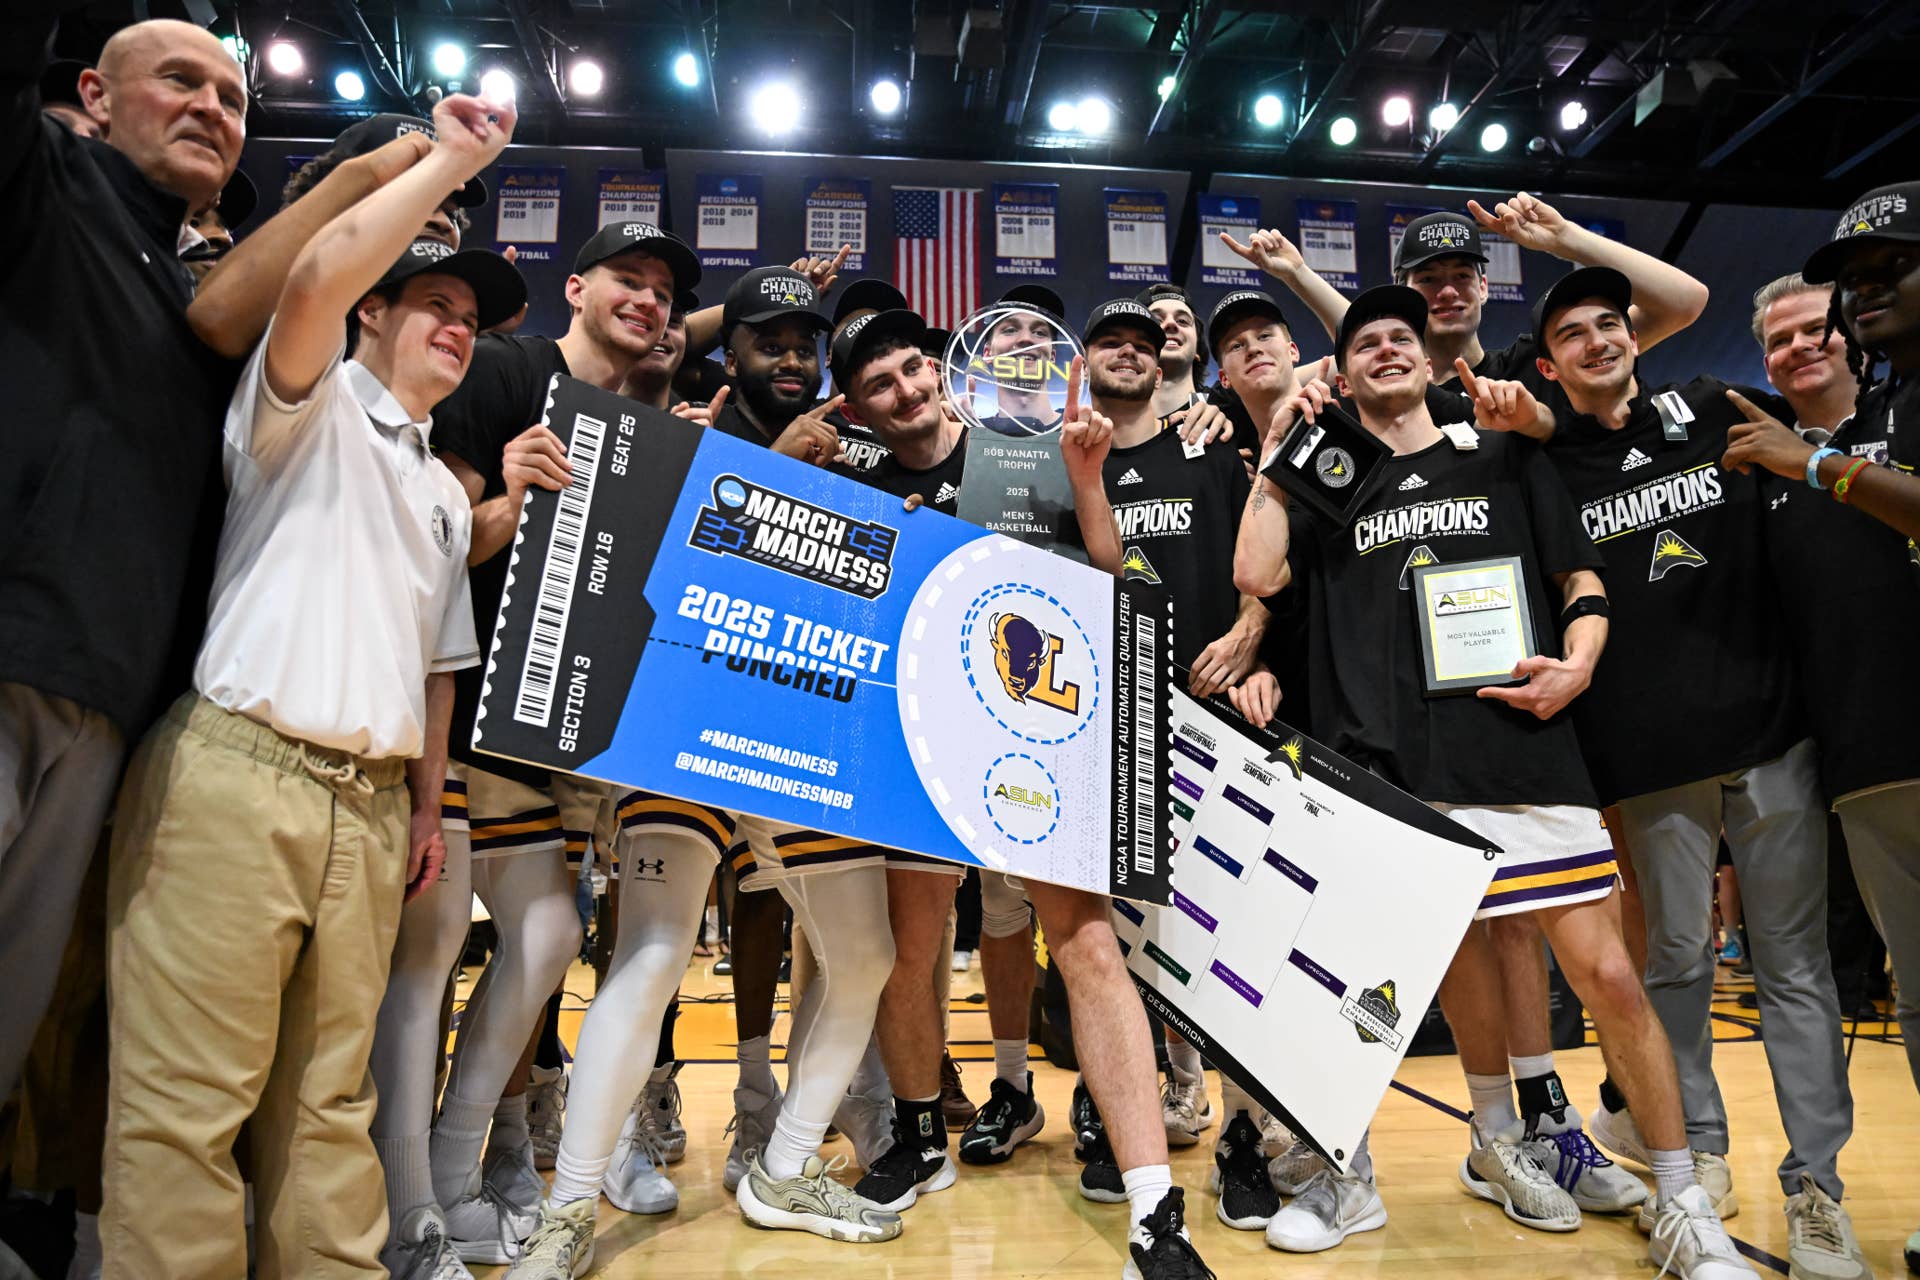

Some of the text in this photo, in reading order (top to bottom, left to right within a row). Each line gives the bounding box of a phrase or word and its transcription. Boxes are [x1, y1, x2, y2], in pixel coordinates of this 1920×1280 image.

[499, 189, 560, 198] CHAMPIONS
[599, 191, 661, 201] CHAMPIONS
[601, 184, 661, 193] TOURNAMENT
[700, 196, 756, 204] REGIONALS
[806, 199, 868, 209] CHAMPIONS
[995, 205, 1056, 215] CHAMPIONS
[1107, 212, 1167, 222] CHAMPIONS
[1201, 215, 1258, 226] TOURNAMENT
[1299, 219, 1355, 230] TOURNAMENT
[1875, 215, 1891, 227] 25
[1419, 226, 1471, 242] CHAMPS
[810, 240, 833, 249] 2022
[1428, 239, 1465, 248] 20 25
[702, 258, 751, 267] SOFTBALL
[996, 265, 1057, 276] BASKETBALL
[1010, 258, 1042, 267] MEN'S
[1123, 265, 1155, 274] MEN'S
[1108, 271, 1169, 283] BASKETBALL
[1202, 274, 1262, 287] BASKETBALL
[1216, 268, 1247, 278] MEN'S
[760, 281, 813, 301] CHAMPS
[770, 294, 809, 307] 20 25
[610, 413, 637, 477] SEAT 25
[983, 447, 1051, 460] BOB VANATTA
[997, 460, 1037, 471] TROPHY
[1621, 455, 1653, 472] adidas
[1117, 476, 1144, 487] adidas
[1398, 479, 1429, 492] adidas
[1006, 487, 1030, 498] 2025
[1580, 471, 1683, 511] ATLANTIC SUN CONFERENCE
[1121, 498, 1162, 509] CONFERENCE
[1580, 466, 1723, 541] CHAMPIONS
[1657, 511, 1682, 524] MEN'S
[1683, 497, 1726, 516] BASKETBALL
[744, 489, 847, 545] MARCH
[1002, 510, 1035, 521] MEN'S
[1113, 501, 1194, 537] MPIONS
[985, 521, 1052, 535] BASKETBALL
[1354, 500, 1490, 552] CHAMPIONS
[1443, 529, 1491, 537] BASKETBALL
[1131, 529, 1192, 540] MEN'S BASKETBALL
[587, 531, 614, 596] ROW 16
[752, 524, 888, 591] MADNESS
[677, 584, 890, 675] 2025 TICKET
[1119, 592, 1131, 660] QUALIFIER
[1447, 628, 1506, 641] MOST VALUABLE
[1463, 638, 1492, 648] PLAYER
[701, 628, 858, 704] PUNCHED
[558, 654, 592, 753] SECTION 3
[1117, 661, 1130, 743] AUTOMATIC
[1179, 724, 1217, 752] QUARTERFINALS
[699, 728, 839, 777] #MARCHMADNESS
[1182, 744, 1205, 761] LIPSCOMB
[1310, 754, 1329, 769] MARCH
[675, 751, 854, 811] @MARCHMADNESSMBB
[1242, 762, 1273, 788] SEMIFINALS
[1116, 745, 1129, 846] TOURNAMENT
[1236, 795, 1261, 814] LIPSCOMB
[1303, 801, 1320, 819] FINAL
[1209, 848, 1229, 864] QUEENS
[1116, 848, 1128, 885] NCAA
[1278, 860, 1304, 881] LIPSCOMB
[1190, 908, 1212, 926] ALABAMA
[1304, 962, 1331, 984] LIPSCOMB
[1217, 966, 1257, 1000] NORTH ALABAMA
[1146, 993, 1207, 1050] DESTINATION.
[1345, 1008, 1396, 1047] CHAMPIONSHIP
[1366, 1014, 1395, 1039] BASKETBALL
